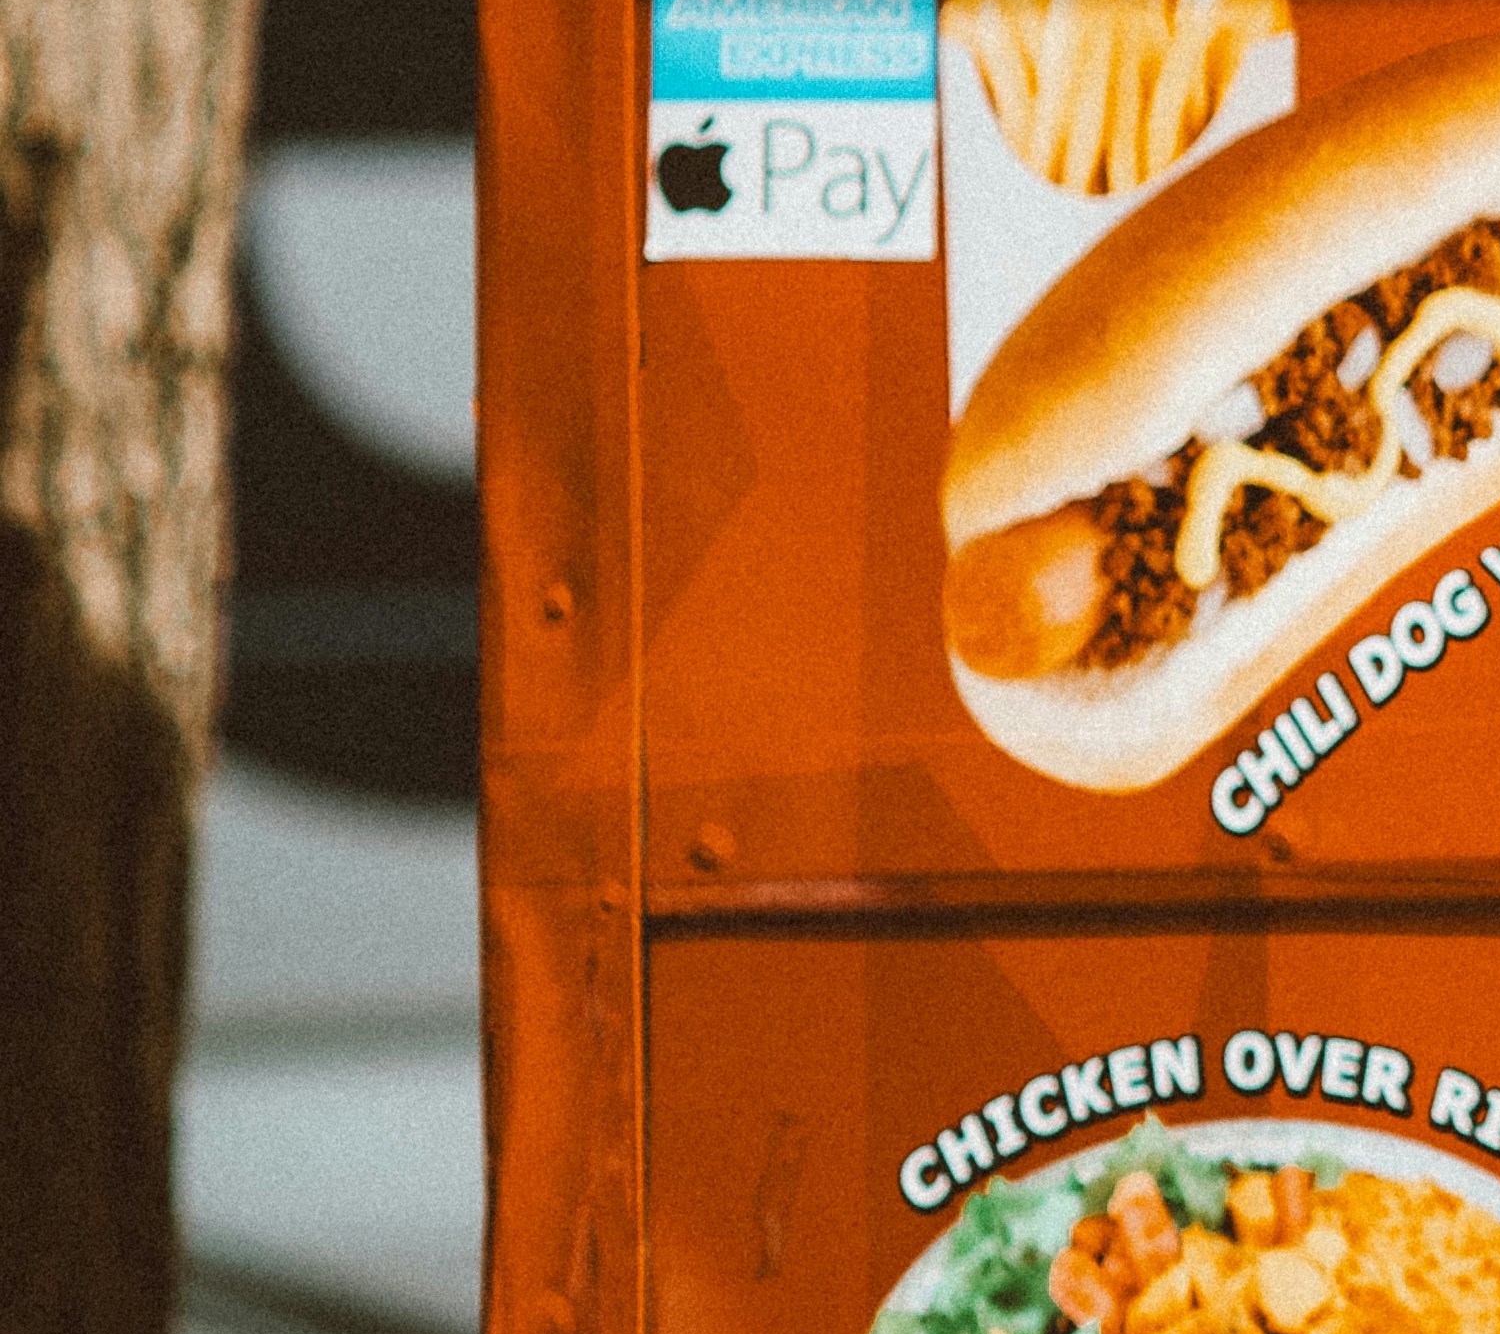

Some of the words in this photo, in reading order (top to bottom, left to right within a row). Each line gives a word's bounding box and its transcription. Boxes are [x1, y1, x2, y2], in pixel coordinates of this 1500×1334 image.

[763, 119, 930, 246] Pay
[1209, 671, 1359, 836] CHILI
[1347, 569, 1491, 707] DOG
[899, 1033, 1203, 1209] CHICKEN
[1223, 1029, 1412, 1114] OVER
